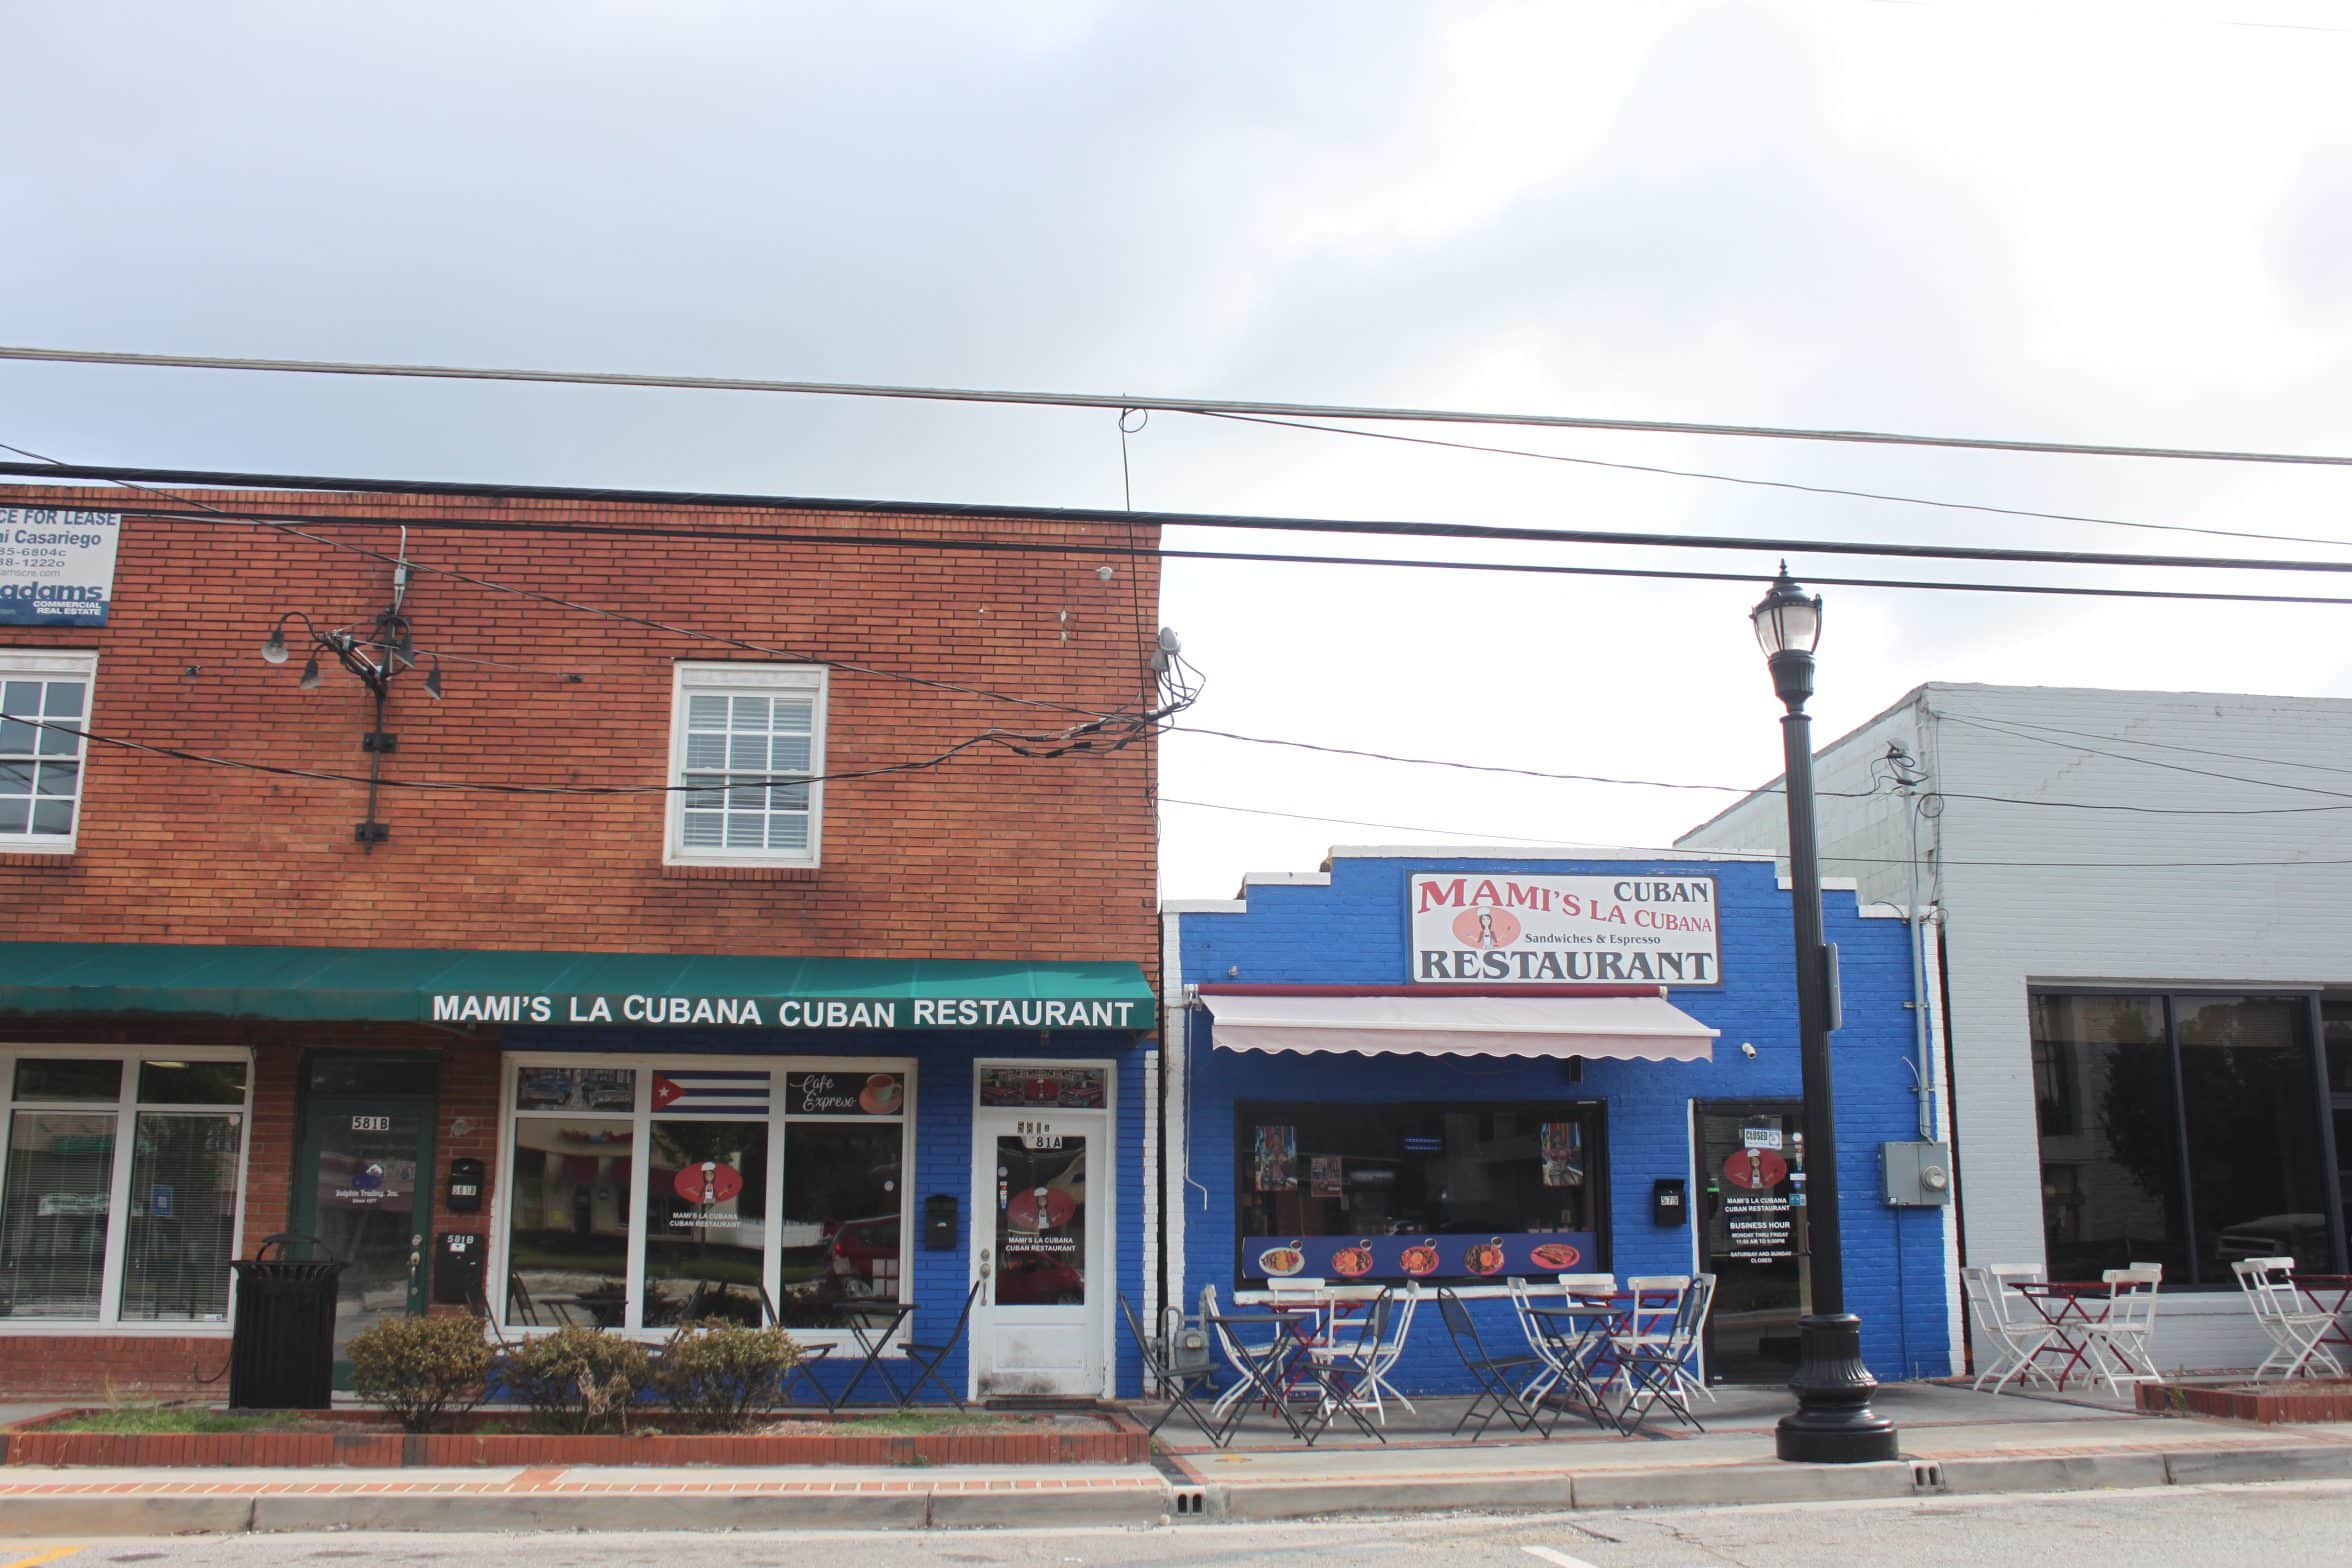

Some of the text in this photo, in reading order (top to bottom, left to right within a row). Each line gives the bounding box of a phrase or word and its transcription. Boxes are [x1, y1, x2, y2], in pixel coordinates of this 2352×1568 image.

[23, 510, 58, 525] FOR
[63, 511, 118, 526] LEASE
[14, 529, 102, 549] Casariego
[0, 581, 103, 601] adams
[33, 601, 102, 609] COMMERCIAL
[36, 607, 102, 616] REAL ESTATE
[1417, 878, 1581, 917] MAMI'S
[1613, 881, 1709, 903] CUBAN
[1590, 899, 1713, 933] LA CUBANA
[1524, 933, 1661, 946] Sandwiches & Espresso
[1419, 950, 1713, 980] RESTAURANT
[432, 994, 1134, 1028] MAMI'S LA CUBANA CUBAN RESTAURANT
[802, 1089, 856, 1112] Expreso
[353, 1117, 389, 1129] 581B
[1745, 1130, 1769, 1141] CLOSED
[1724, 1204, 1790, 1213] CUBAN RESTAURANT
[708, 1212, 738, 1220] CUBANA
[695, 1220, 742, 1228] RESTAURANT
[1729, 1221, 1791, 1229] BUSINESS HOUR
[447, 1234, 475, 1245] 581B
[1005, 1244, 1076, 1252] CUBAN RESTAURANT
